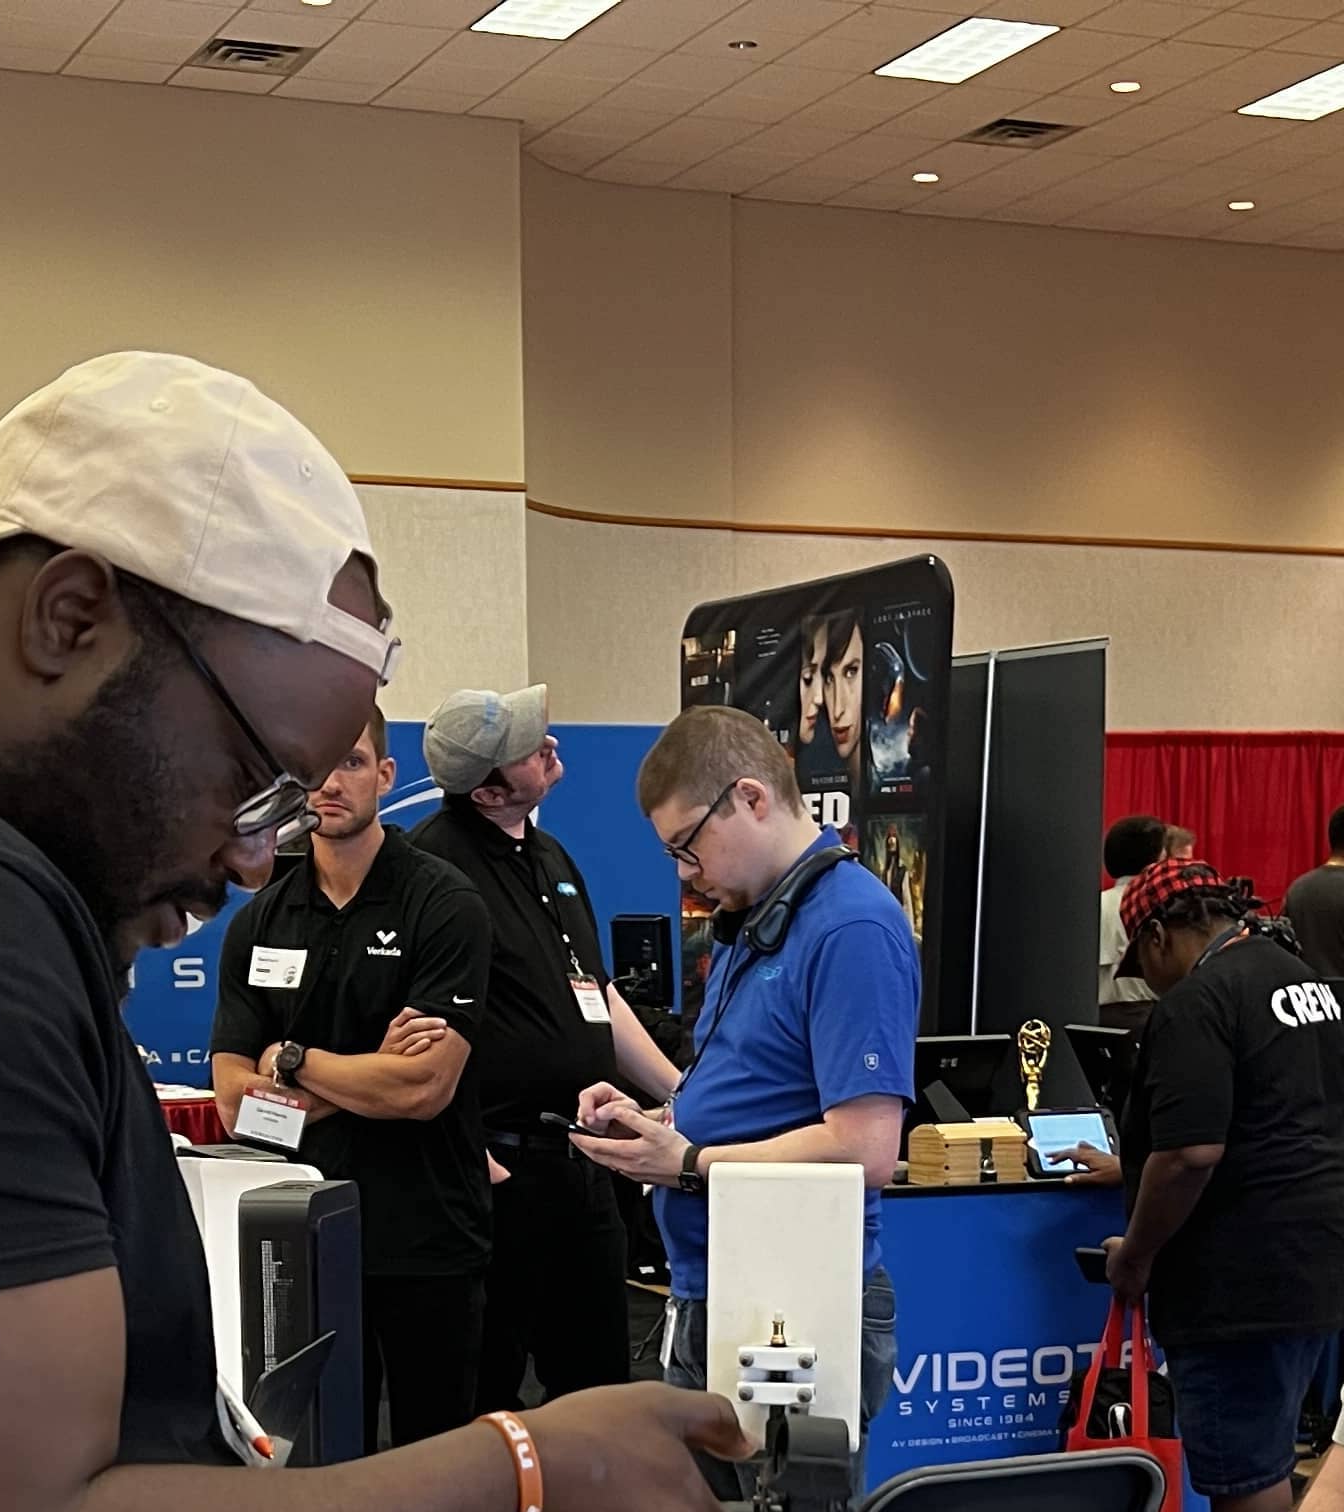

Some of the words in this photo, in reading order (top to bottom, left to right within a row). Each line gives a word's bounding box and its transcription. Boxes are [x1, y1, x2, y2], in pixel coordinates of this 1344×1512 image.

[367, 946, 401, 957] Verkada
[1271, 982, 1341, 1028] CREW
[899, 1390, 1071, 1416] SYSTEMS
[948, 1416, 993, 1429] SINCE
[999, 1412, 1034, 1425] 1984
[892, 1439, 906, 1448] AV
[908, 1438, 943, 1447] DESIGN
[951, 1432, 1009, 1444] BROADCAST
[1017, 1429, 1053, 1439] CINEMA
